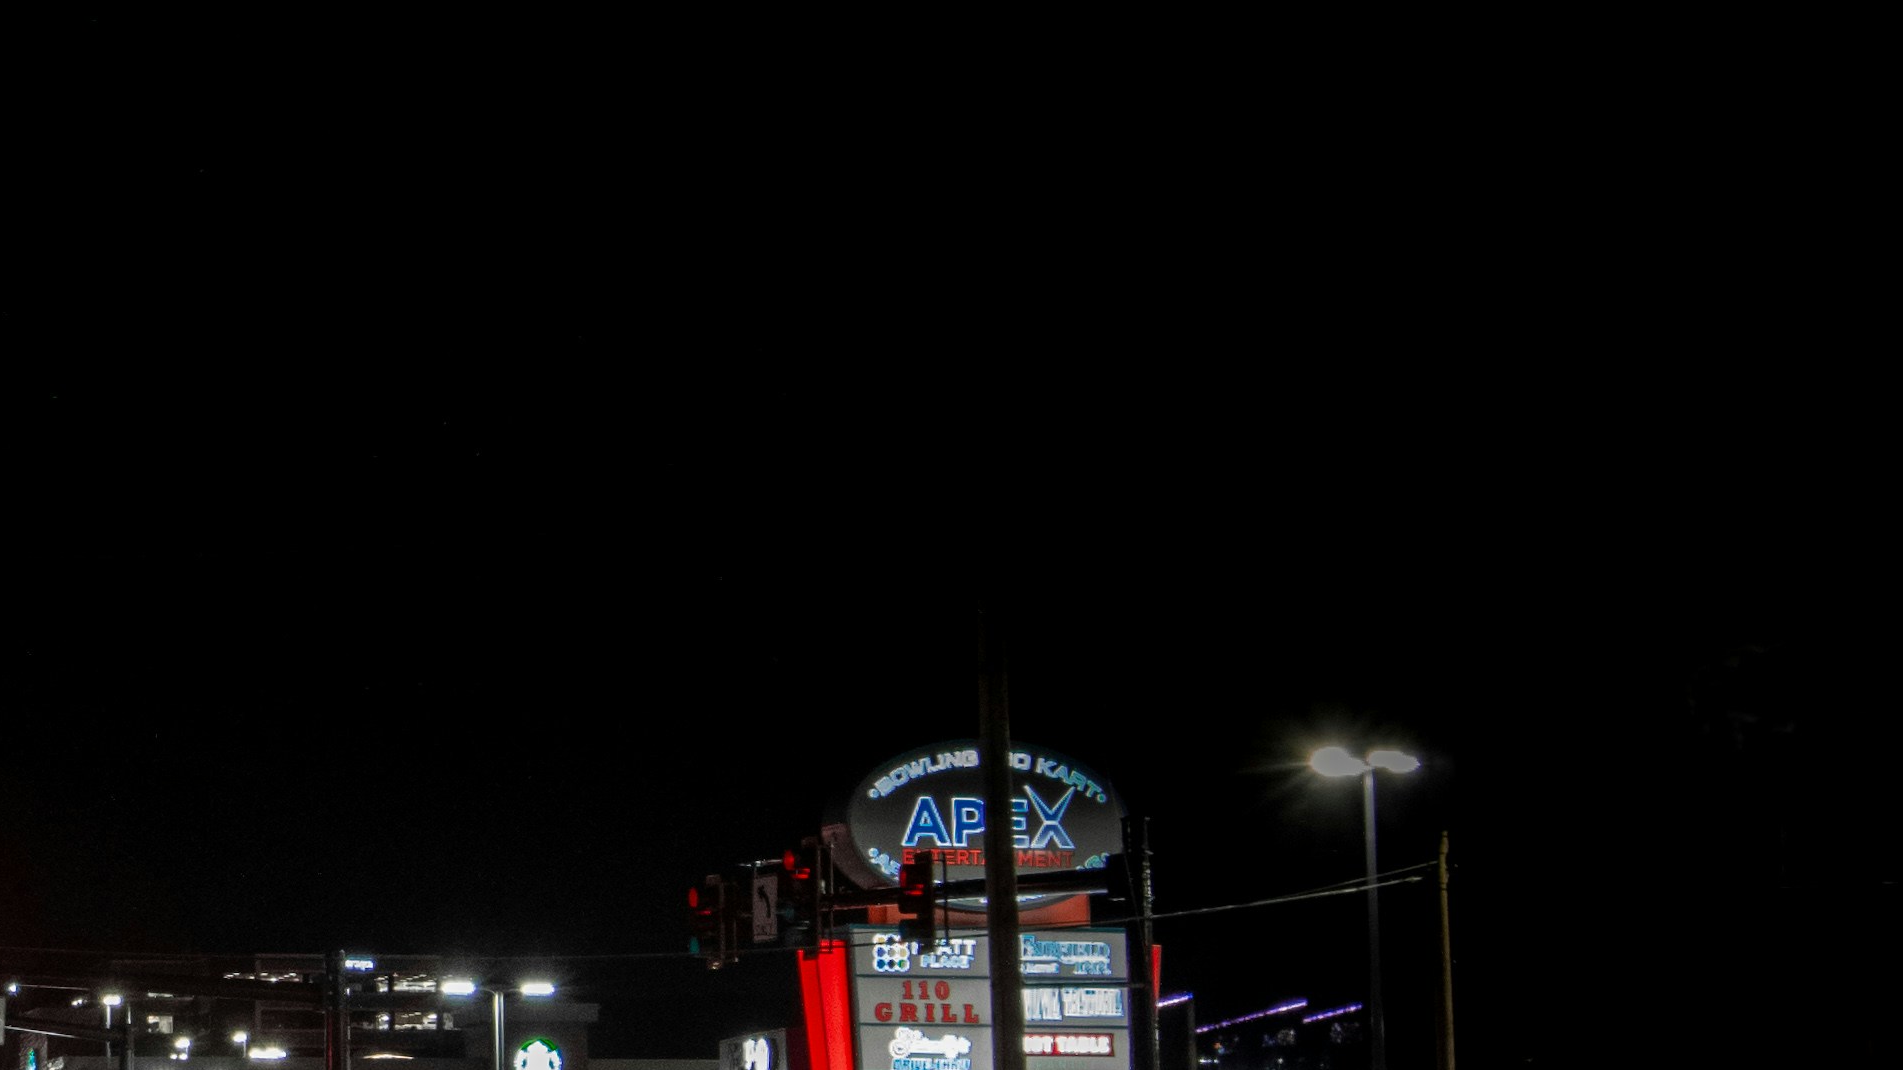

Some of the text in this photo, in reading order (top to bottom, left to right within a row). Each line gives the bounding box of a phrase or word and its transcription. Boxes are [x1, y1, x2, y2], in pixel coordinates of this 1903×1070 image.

[1036, 757, 1101, 798] KART
[901, 785, 1076, 849] APEX
[902, 849, 1074, 868] ETERTMENT
[902, 980, 951, 1001] 110
[874, 1002, 980, 1024] GRILL
